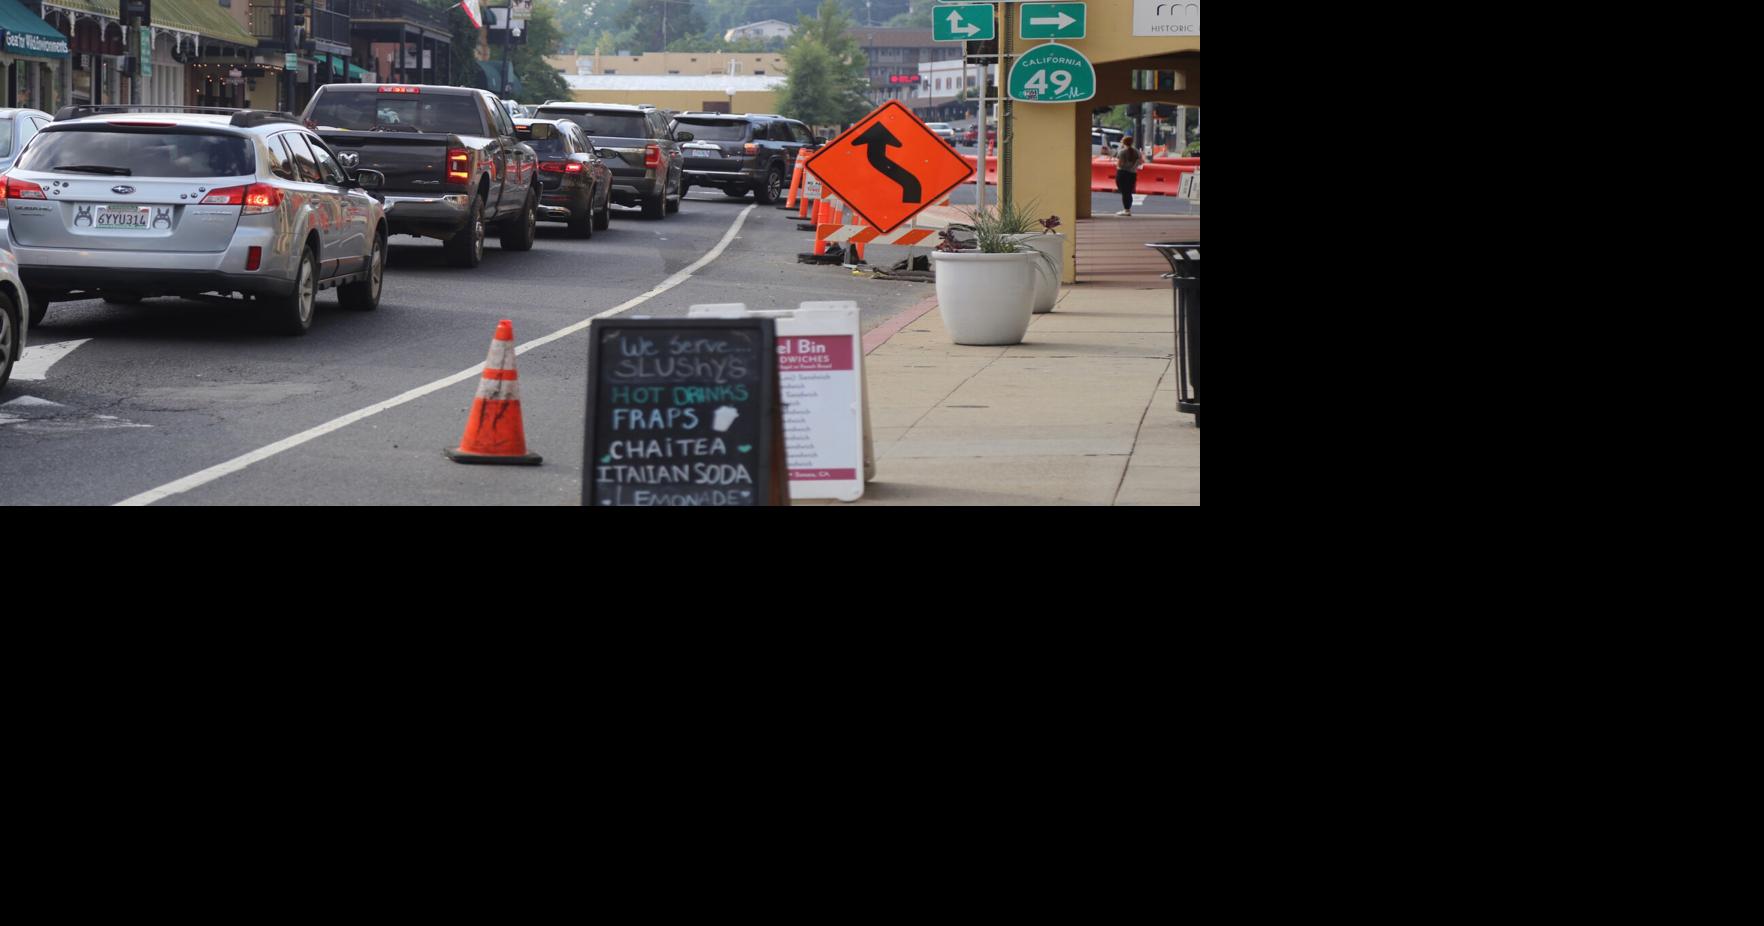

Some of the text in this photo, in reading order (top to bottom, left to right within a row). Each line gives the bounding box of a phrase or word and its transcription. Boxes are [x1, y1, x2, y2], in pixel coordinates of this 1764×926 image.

[1151, 25, 1194, 33] HISTORIC
[1022, 56, 1082, 68] CALIFORNIA
[1024, 69, 1072, 95] 49
[97, 212, 147, 226] 6YYU314
[621, 335, 659, 357] We
[797, 338, 826, 354] Bin
[612, 384, 749, 406] HOT DRINKS
[612, 408, 699, 431] FRAPS
[675, 437, 727, 456] TEA
[695, 462, 753, 485] SODA
